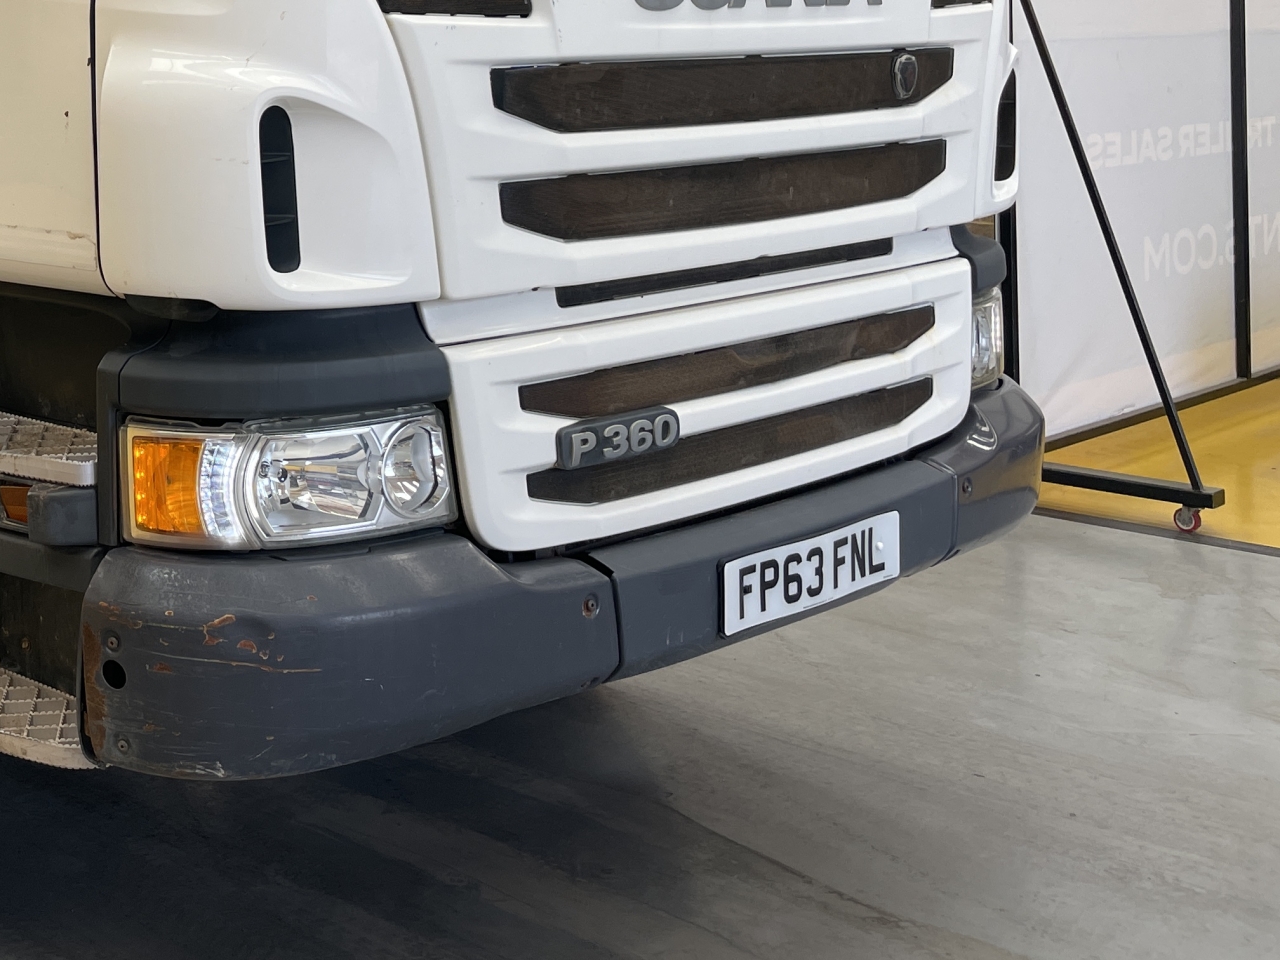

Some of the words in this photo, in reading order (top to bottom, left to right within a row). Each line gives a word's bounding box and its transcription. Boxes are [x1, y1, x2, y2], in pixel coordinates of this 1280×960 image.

[572, 431, 597, 467] P
[603, 414, 678, 459] 360
[739, 546, 824, 620] FP63
[833, 527, 886, 590] FNL
